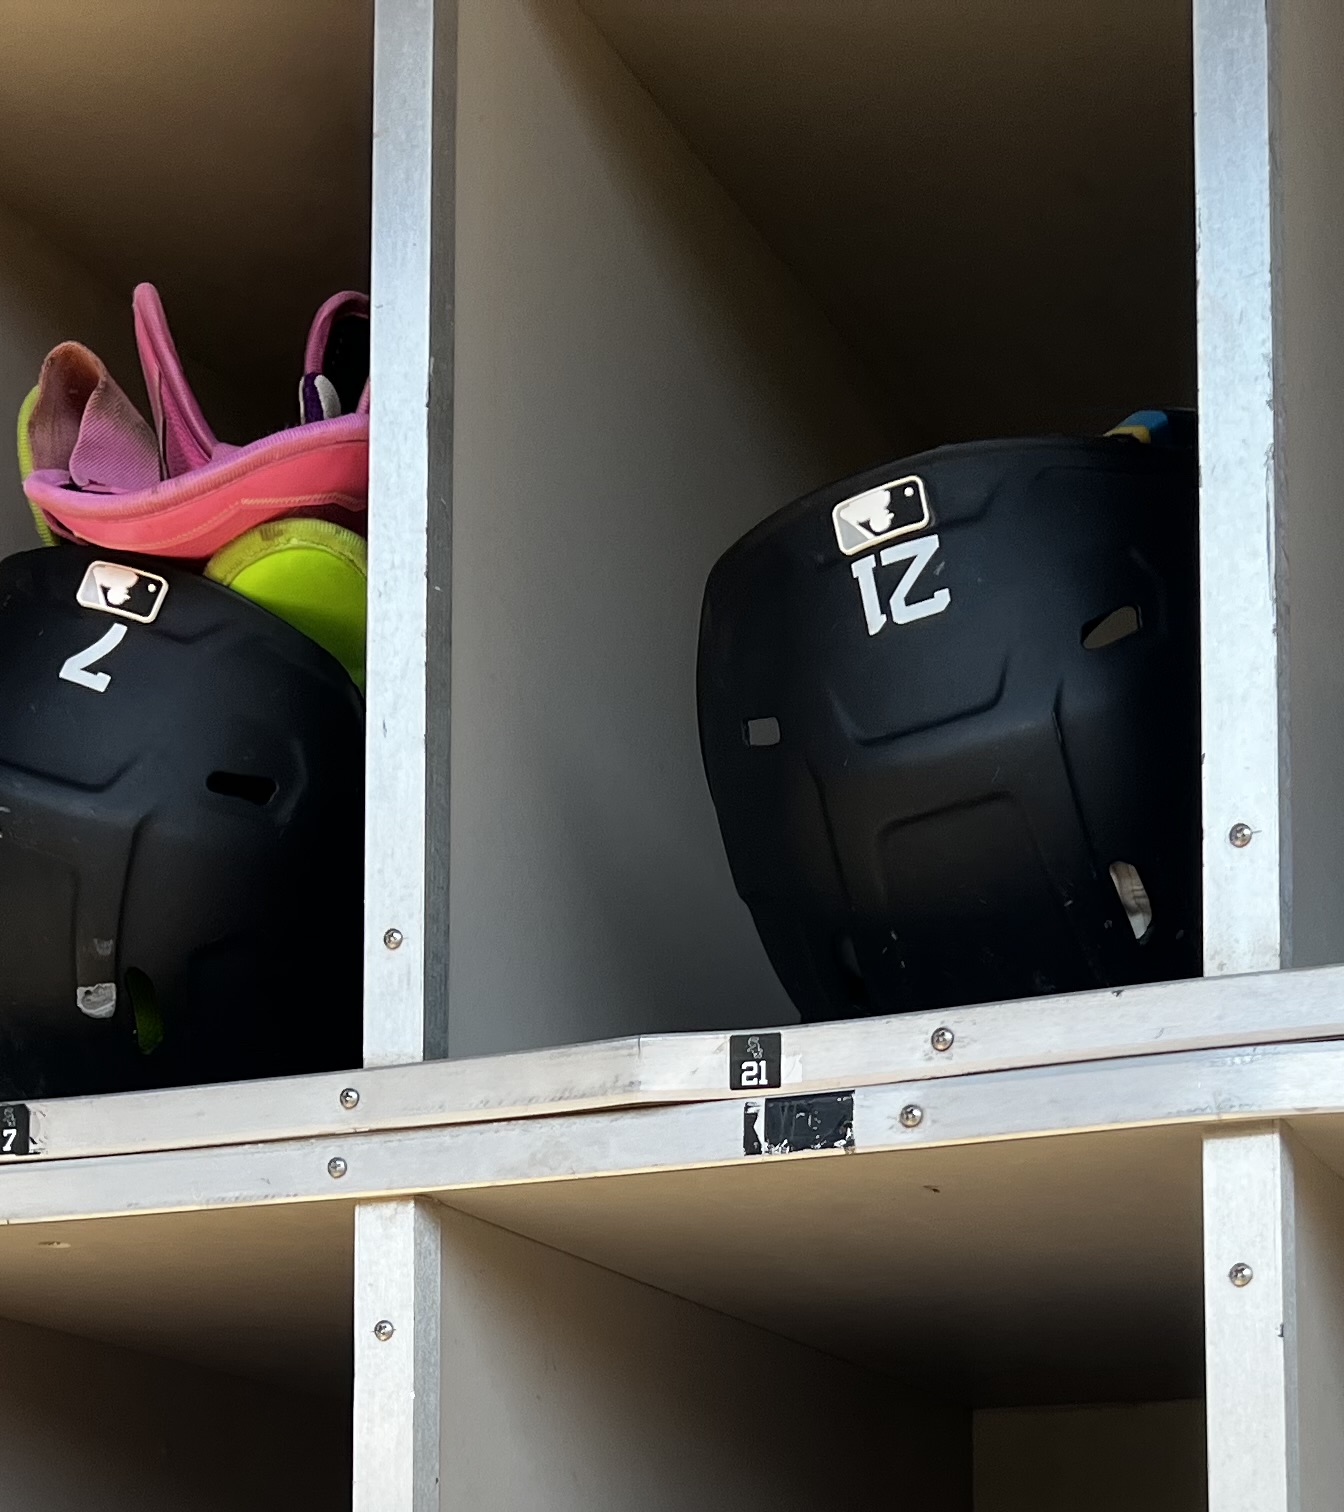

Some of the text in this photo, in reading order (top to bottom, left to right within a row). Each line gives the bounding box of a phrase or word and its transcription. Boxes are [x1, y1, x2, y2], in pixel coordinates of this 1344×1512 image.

[851, 534, 951, 636] 21
[59, 622, 128, 692] 7
[741, 1060, 768, 1087] 21
[2, 1129, 17, 1152] 7
